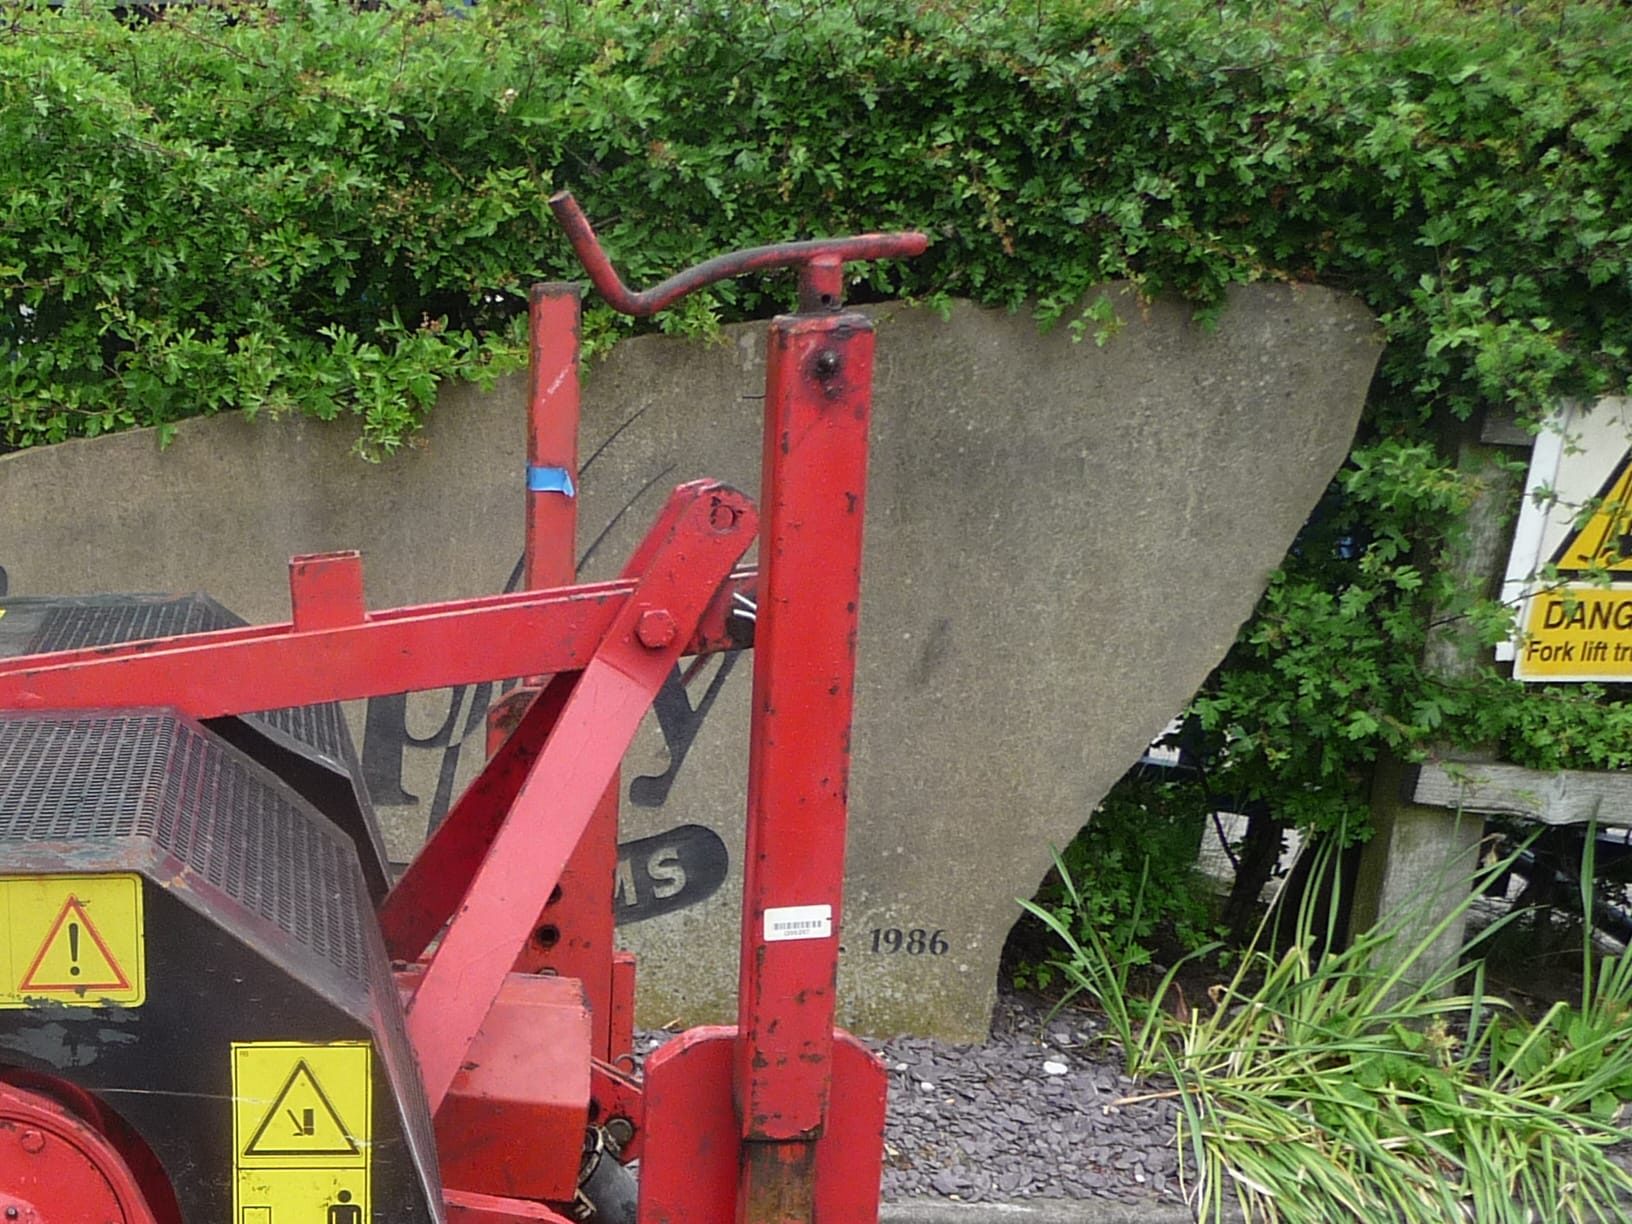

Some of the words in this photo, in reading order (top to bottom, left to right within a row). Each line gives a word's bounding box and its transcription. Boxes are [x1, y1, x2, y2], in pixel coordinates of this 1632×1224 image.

[1526, 640, 1576, 662] Fork
[1580, 640, 1609, 662] lift
[1613, 642, 1632, 662] tr
[869, 927, 950, 956] 1986
